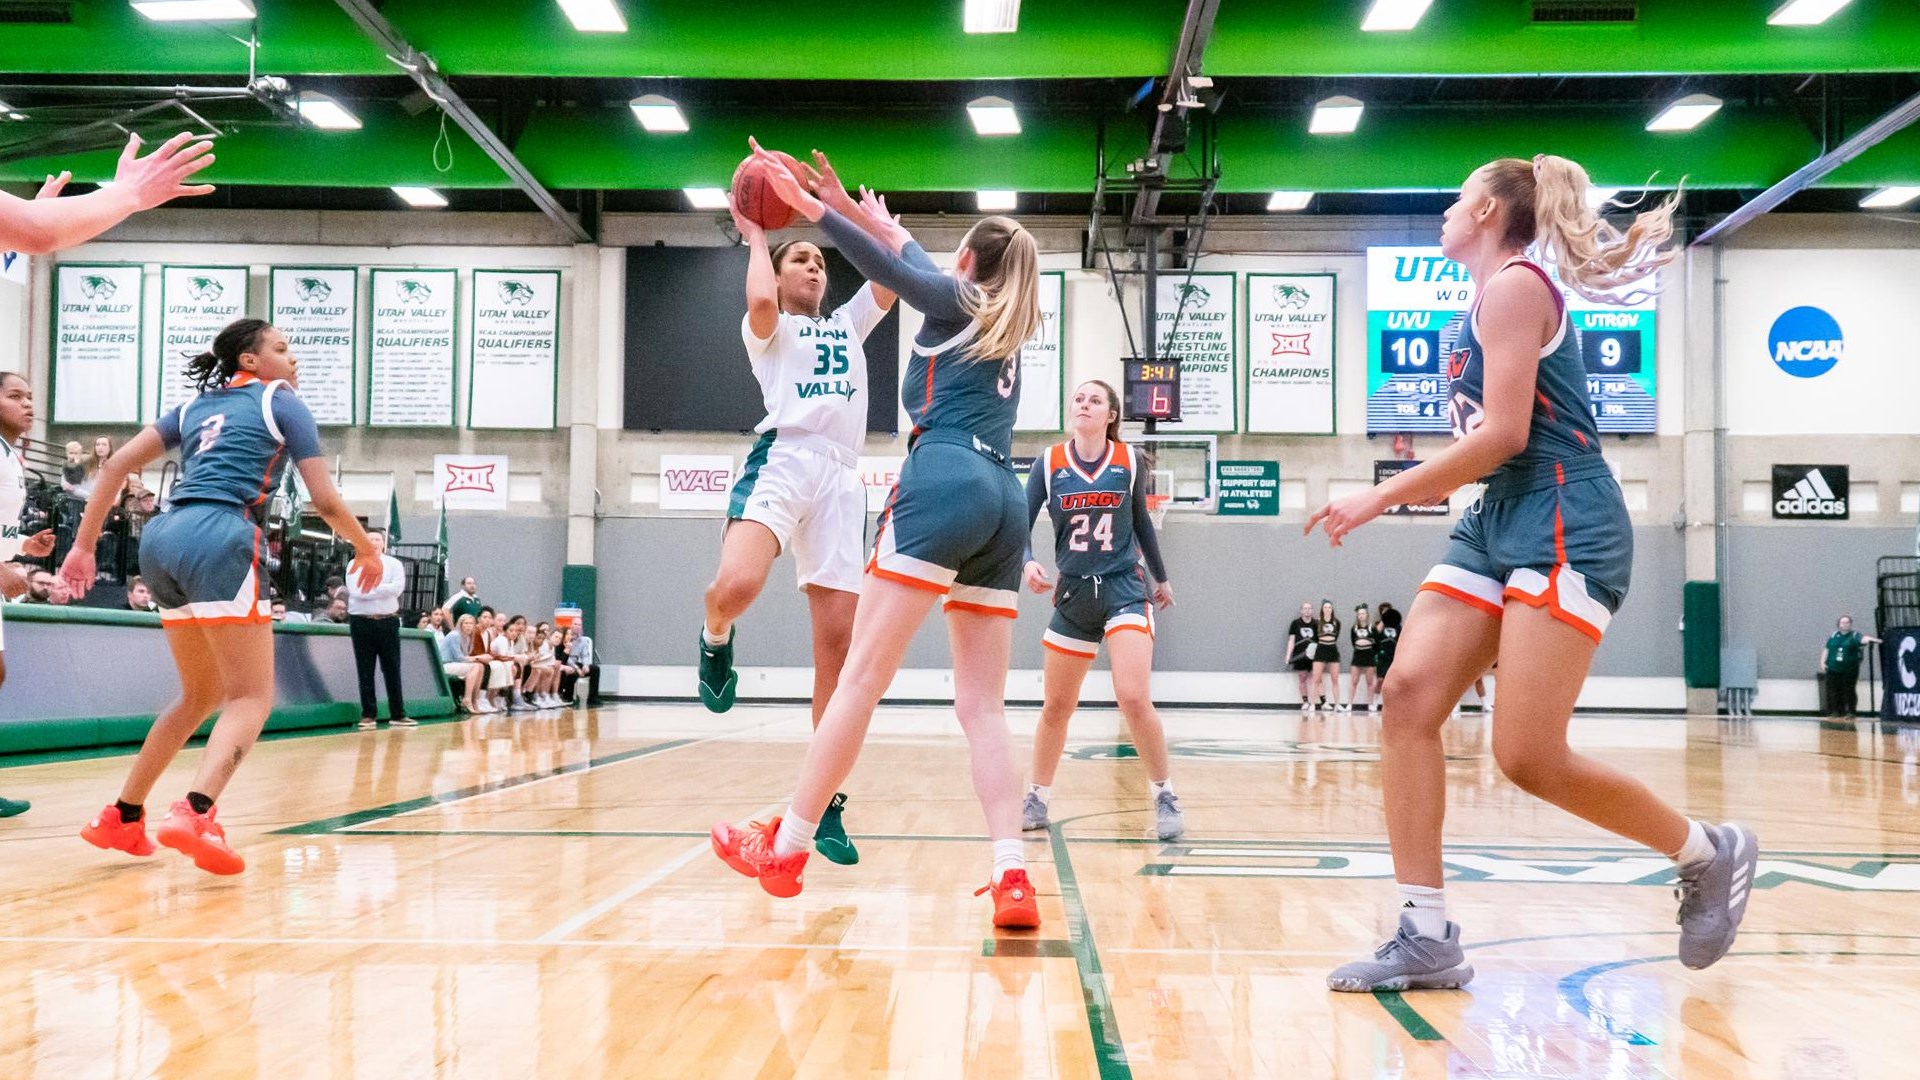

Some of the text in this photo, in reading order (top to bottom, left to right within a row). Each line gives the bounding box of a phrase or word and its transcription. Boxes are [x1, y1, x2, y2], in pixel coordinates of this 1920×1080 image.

[62, 303, 133, 313] UTAH VALLEY
[169, 305, 239, 315] UTAH VALLEY
[277, 306, 348, 316] UTAH VALLEY
[377, 308, 448, 317] UTAH VALLEY
[479, 309, 551, 319] UTAH VALLEY
[1155, 312, 1227, 321] UTAH VALLEY
[1254, 313, 1328, 322] UTAH VALLEY
[1387, 311, 1431, 329] UVU
[1584, 313, 1640, 328] UTRGV
[62, 333, 135, 344] QUALIFIERS
[799, 326, 848, 340] UTAH
[1163, 331, 1223, 341] WESTERN
[167, 334, 213, 345] QUALIF
[286, 335, 350, 346] ALIFIERS
[376, 337, 449, 348] QUALIFIERS
[477, 338, 552, 349] QUALIFIERS
[1157, 342, 1228, 351] WRESTLING
[1391, 337, 1429, 366] 10
[1600, 337, 1621, 366] 9
[1775, 339, 1844, 361] NCAA
[814, 344, 849, 375] 35
[1141, 364, 1174, 380] 3:41
[1180, 363, 1228, 373] MPIONS
[1252, 367, 1330, 378] CHAMPIONS
[1420, 379, 1438, 394] 01
[1152, 386, 1168, 412] 6
[1423, 403, 1435, 416] 4
[197, 413, 225, 455] 2
[665, 470, 728, 491] WAC
[1222, 479, 1258, 487] SUPPORT
[1260, 479, 1276, 487] OUR
[1230, 490, 1272, 498] ATHLETES!
[1057, 491, 1127, 511] UTRGV
[1775, 497, 1846, 515] adidas
[1068, 513, 1113, 552] 24
